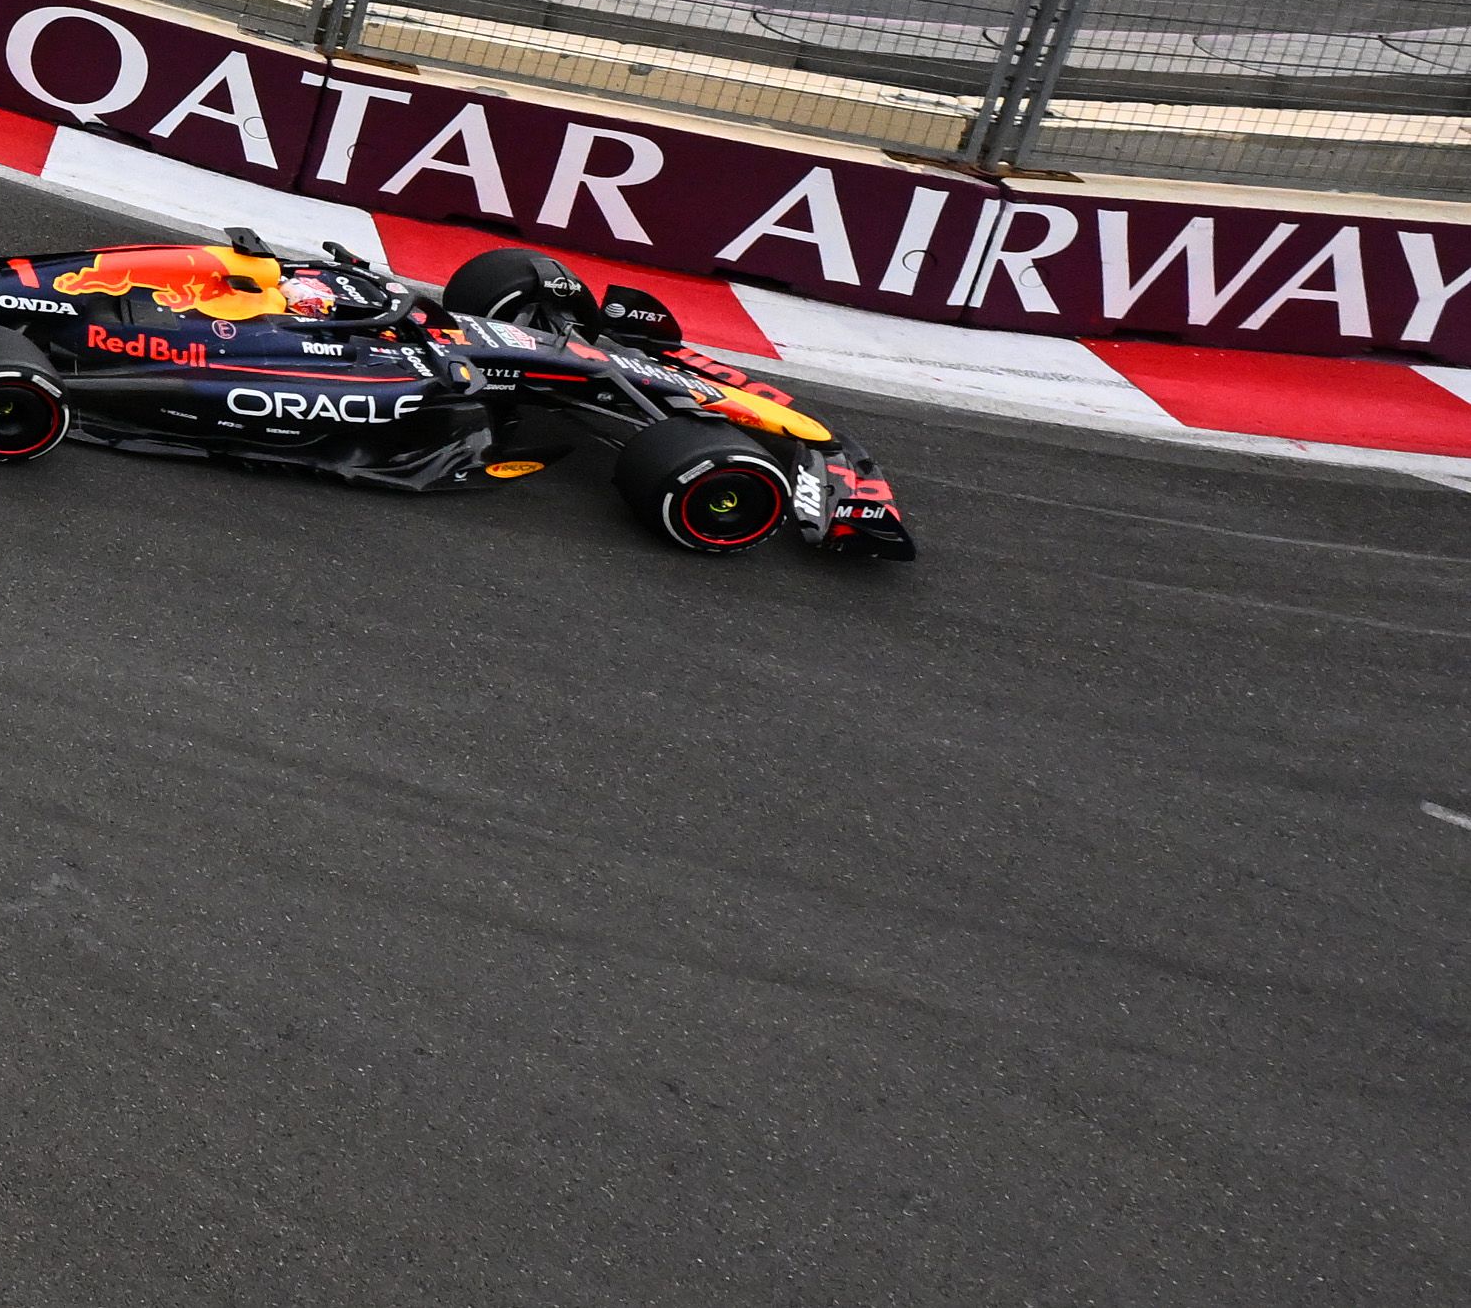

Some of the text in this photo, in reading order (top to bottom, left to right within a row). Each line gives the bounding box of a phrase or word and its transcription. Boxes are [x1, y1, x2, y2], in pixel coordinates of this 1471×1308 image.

[5, 5, 667, 245] QATAR
[714, 165, 1471, 350] AIRWAY
[7, 258, 39, 288] 1
[627, 310, 666, 323] AT&T
[88, 324, 206, 368] Red Bull
[302, 341, 344, 357] ROKT
[483, 369, 521, 379] LYLE
[483, 383, 516, 391] sword
[227, 388, 423, 424] ORACLE
[836, 505, 886, 519] Mobil
